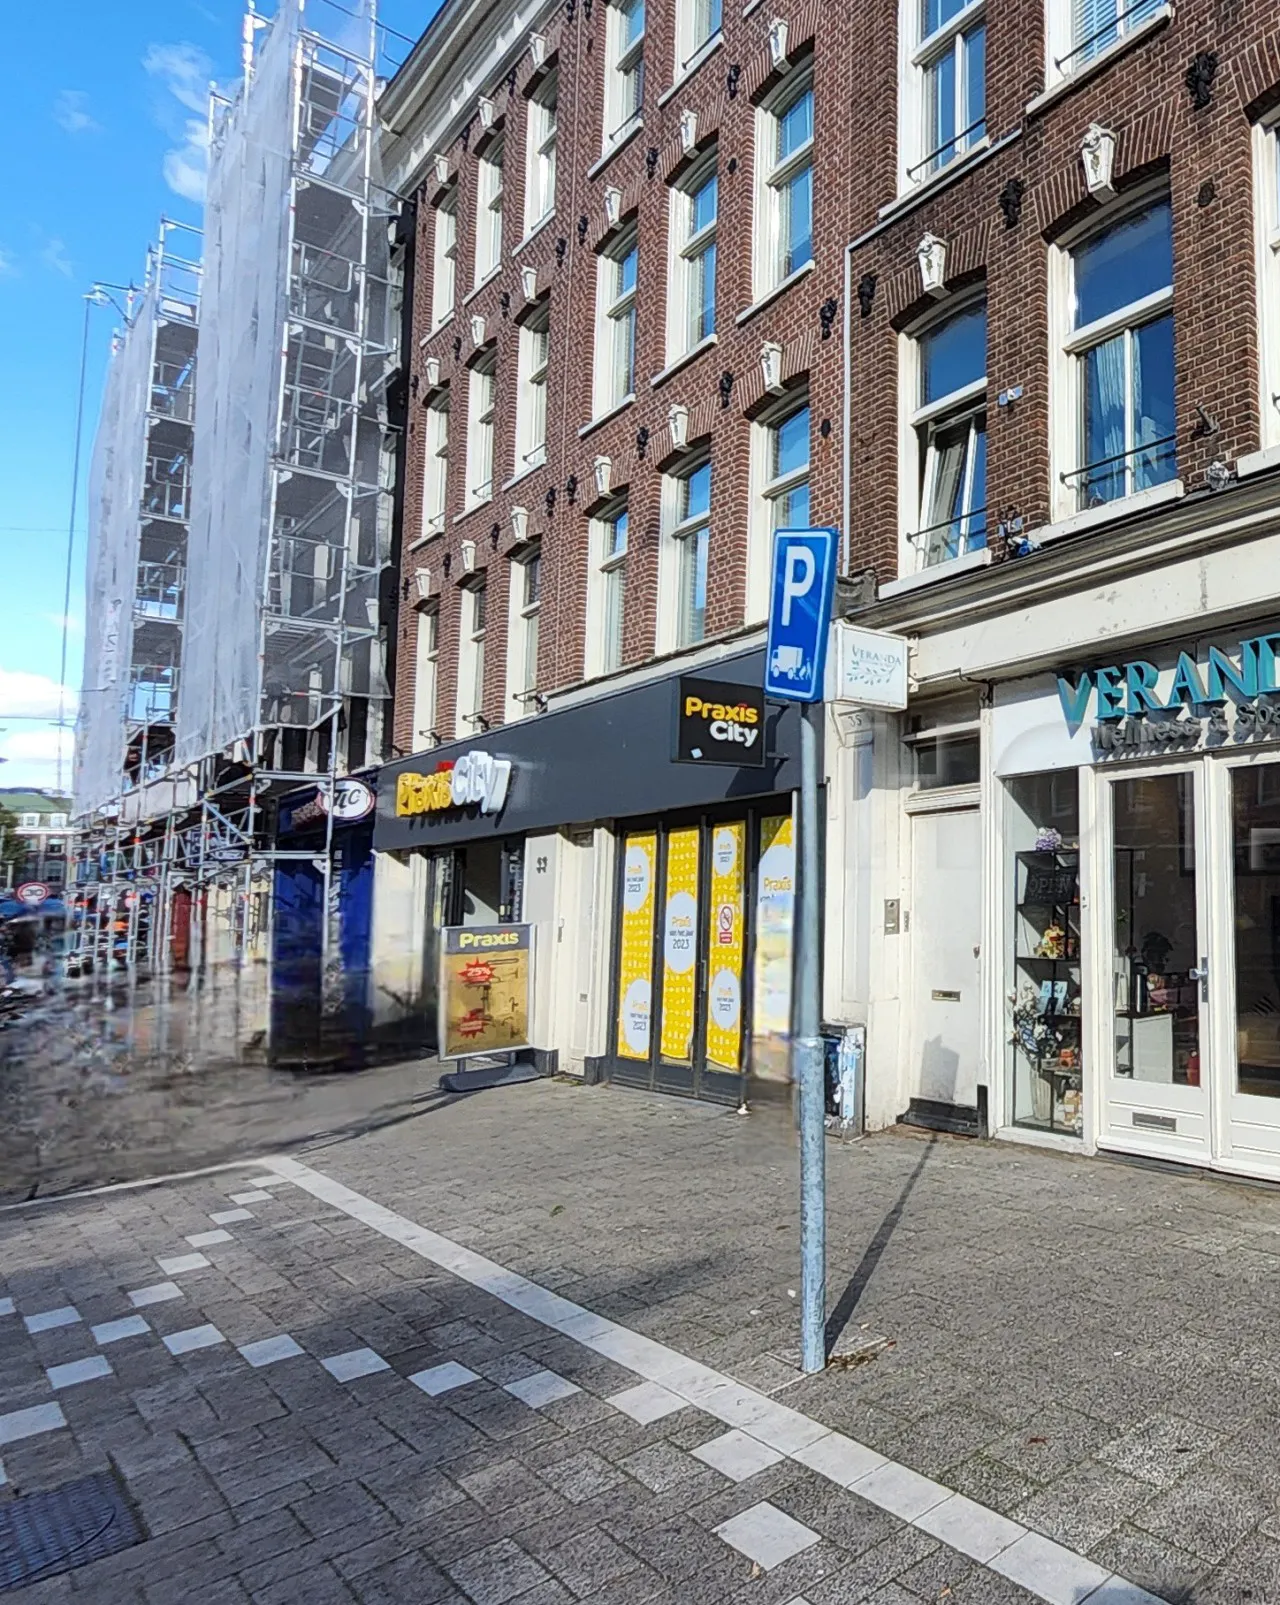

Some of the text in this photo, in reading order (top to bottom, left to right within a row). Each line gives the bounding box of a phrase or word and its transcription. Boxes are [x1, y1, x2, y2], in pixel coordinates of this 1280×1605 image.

[781, 545, 816, 627] P
[852, 643, 902, 667] VERANDA
[685, 696, 758, 724] Praxis
[709, 720, 759, 747] City
[459, 929, 519, 949] Praxis
